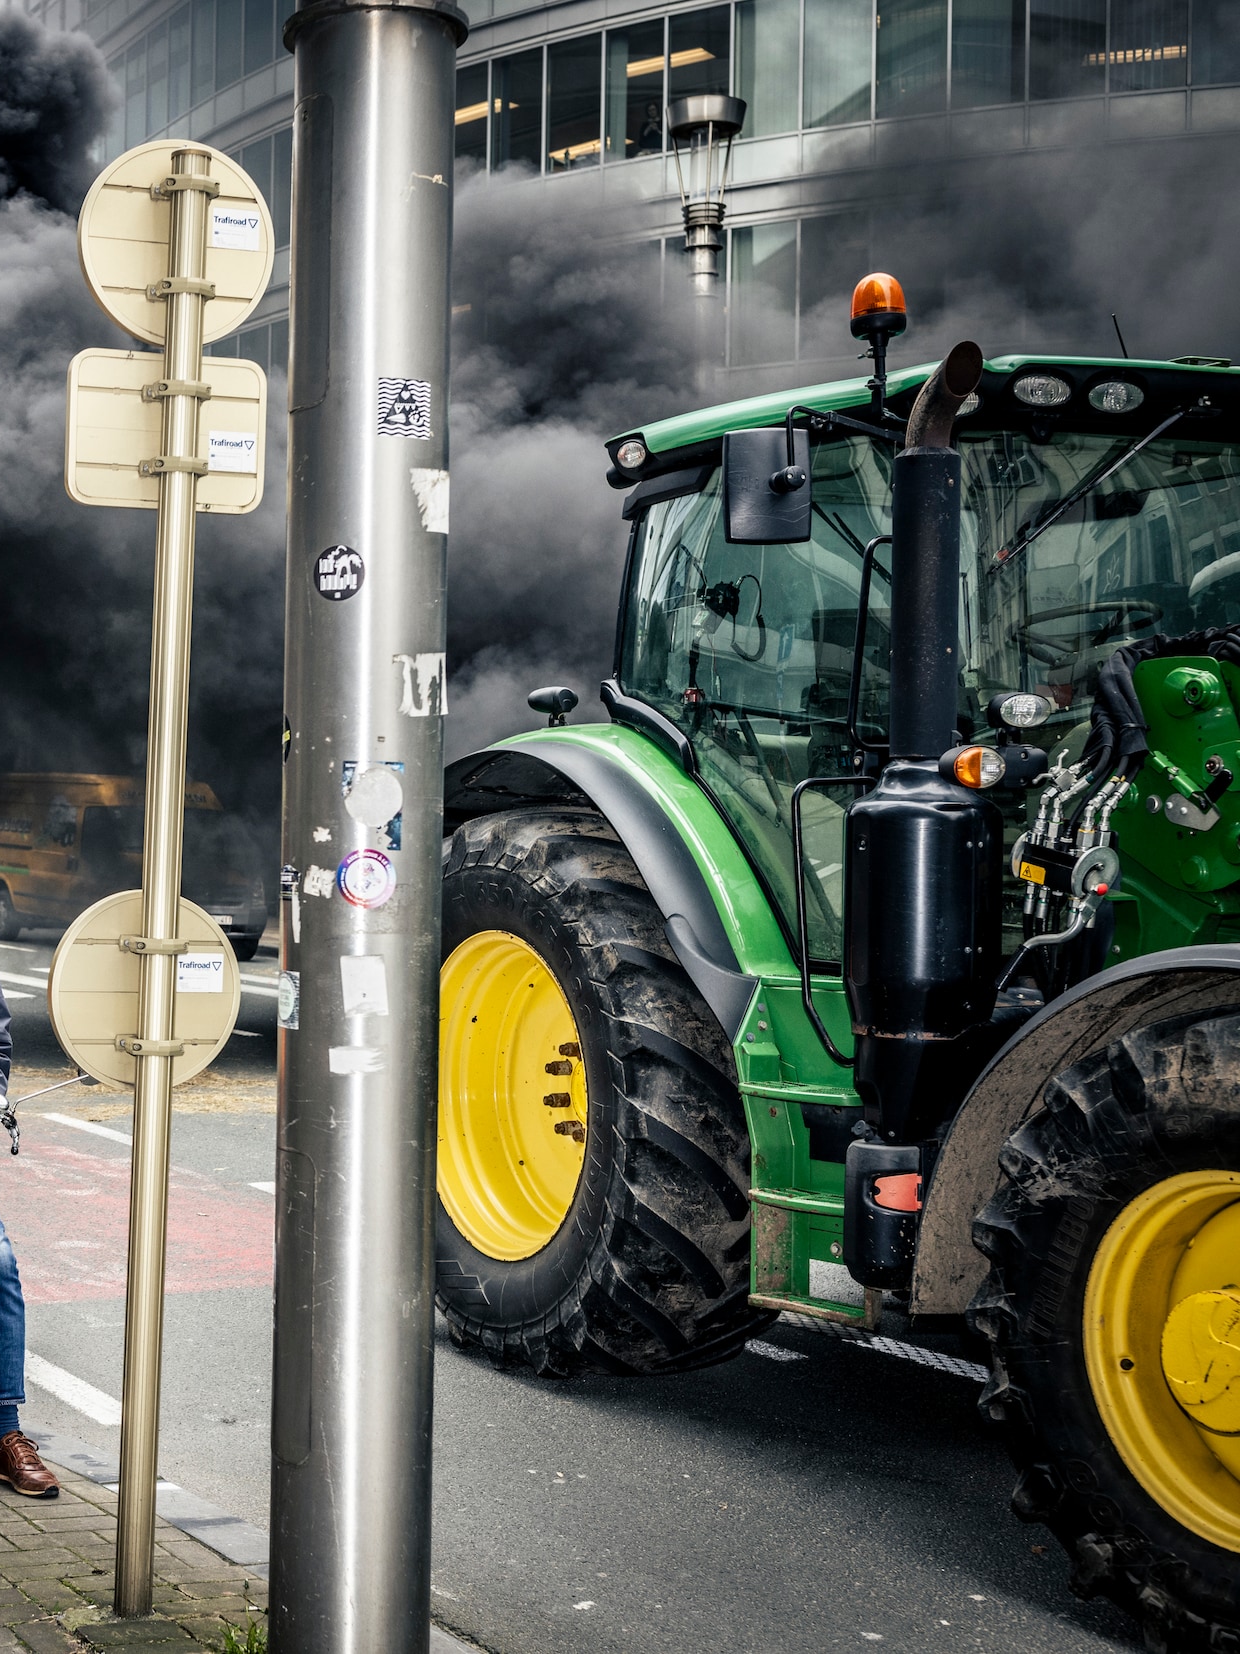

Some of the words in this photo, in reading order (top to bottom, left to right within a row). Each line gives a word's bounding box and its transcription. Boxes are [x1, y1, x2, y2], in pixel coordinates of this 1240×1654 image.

[213, 215, 247, 226] Trafiroad
[209, 438, 243, 448] Trafiroad
[178, 961, 211, 969] Trafiroad
